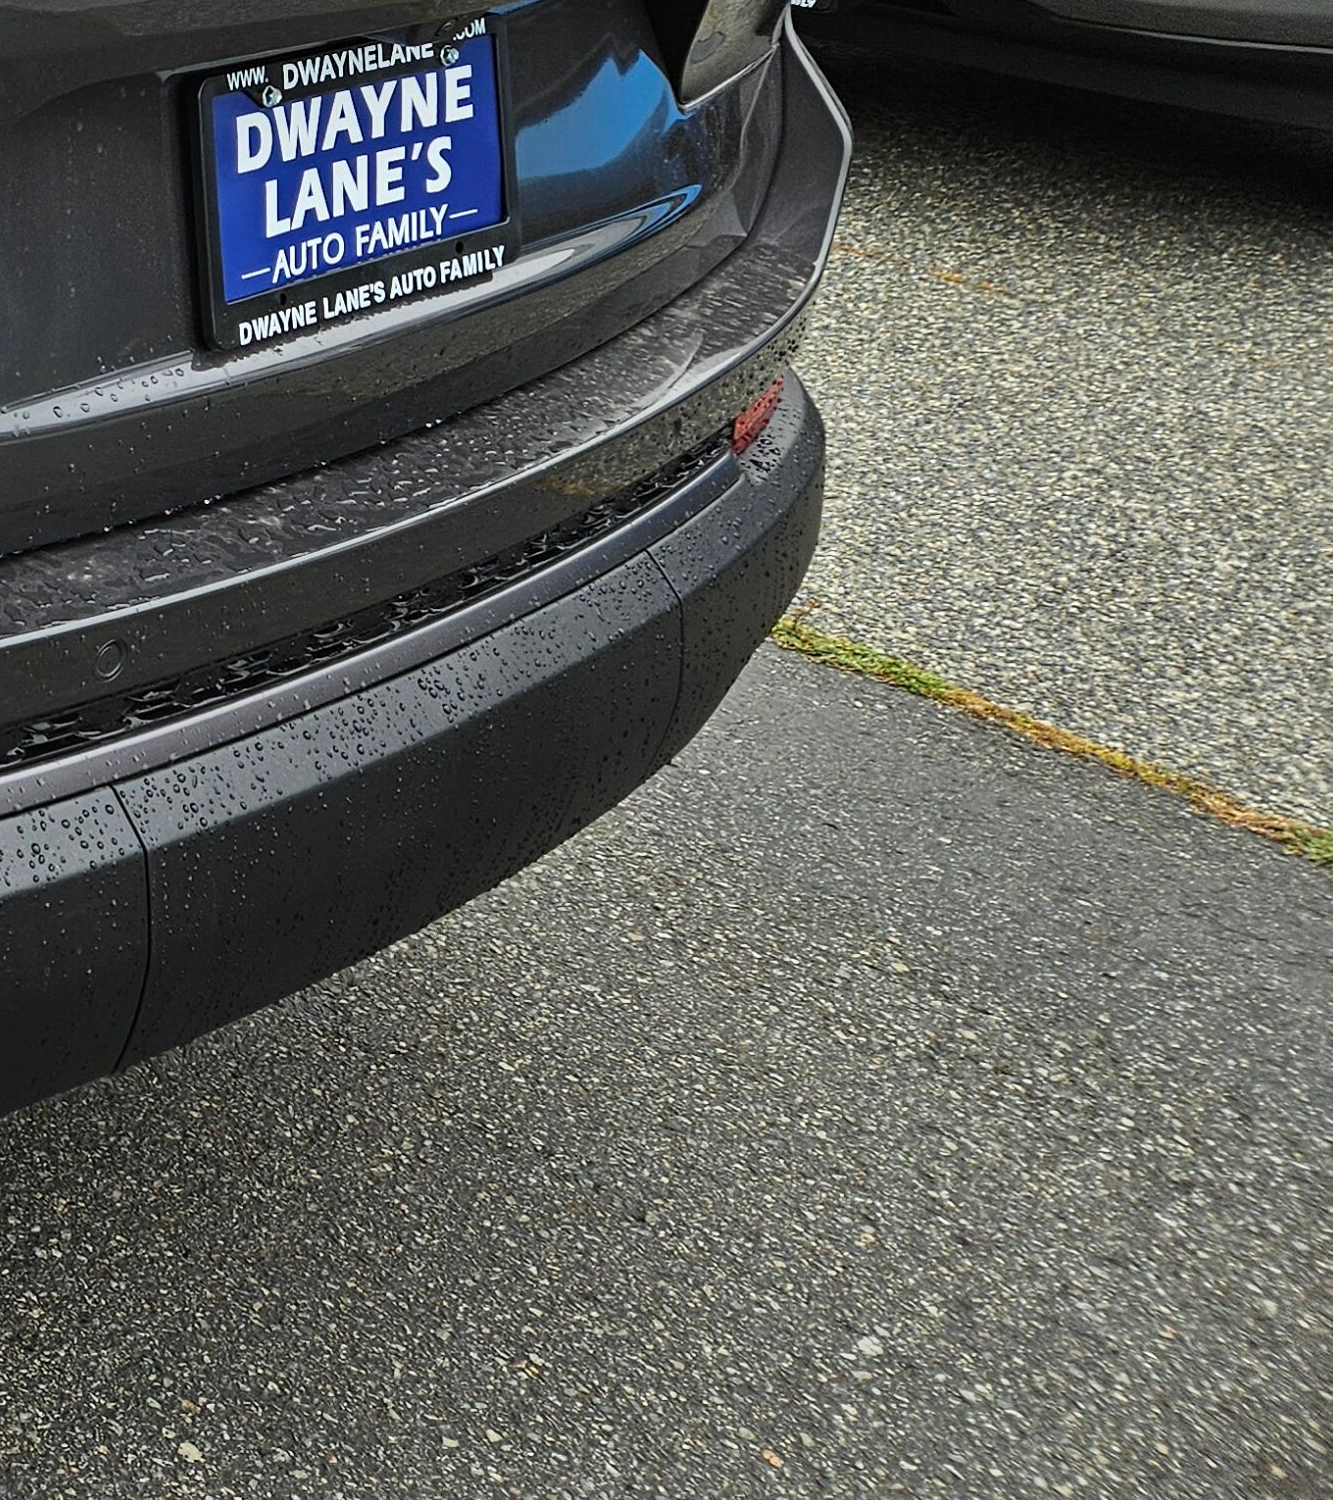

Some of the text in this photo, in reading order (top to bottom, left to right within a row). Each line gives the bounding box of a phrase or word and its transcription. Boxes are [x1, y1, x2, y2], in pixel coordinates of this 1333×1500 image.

[235, 64, 474, 175] DWAYNE
[264, 135, 453, 240] LANE'S
[272, 203, 450, 284] AUTO FAMILY
[238, 245, 506, 347] DWAYNE LANE'S AUTO FAMILY
